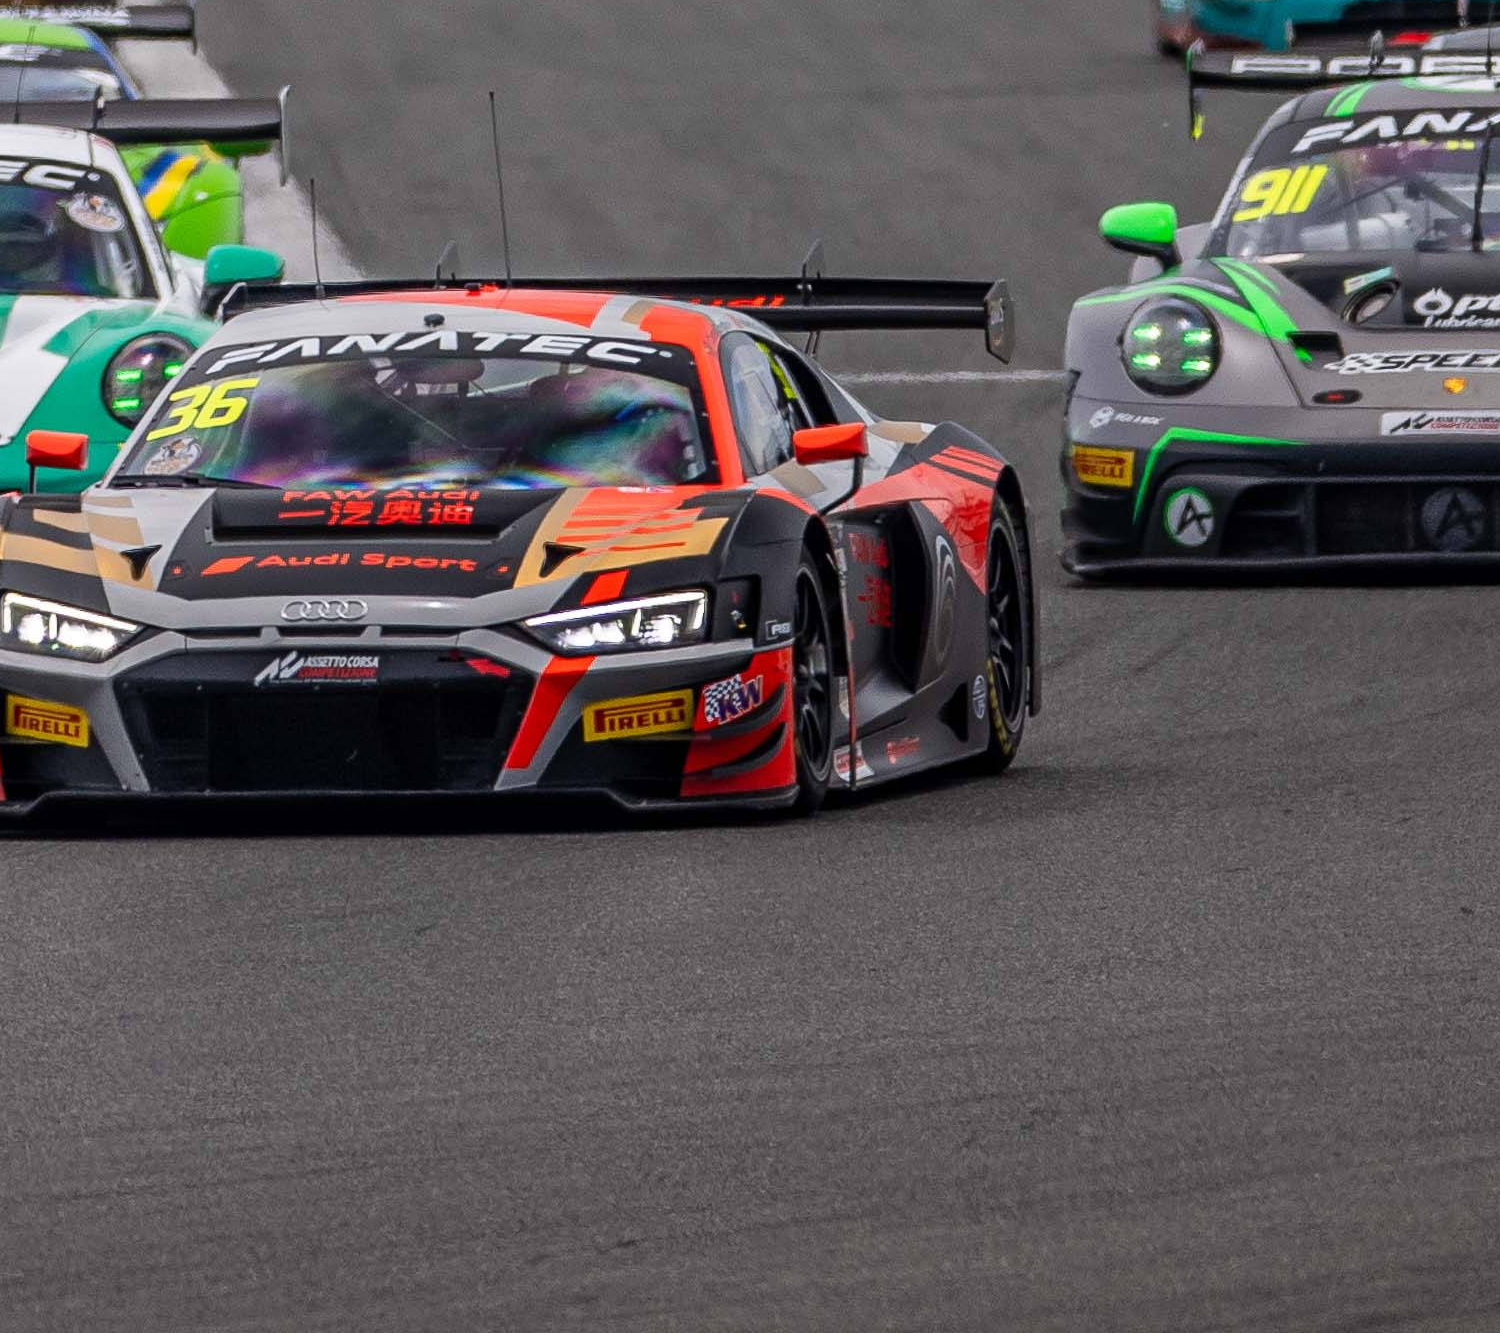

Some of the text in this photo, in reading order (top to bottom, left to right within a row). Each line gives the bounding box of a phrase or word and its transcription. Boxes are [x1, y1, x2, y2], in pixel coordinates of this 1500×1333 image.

[1231, 163, 1331, 222] 911
[206, 330, 660, 376] FANATEC
[146, 377, 260, 442] 36
[281, 488, 481, 503] FAW Audi
[278, 500, 474, 527] 一汽奥迪
[255, 552, 478, 572] Audi Sport
[302, 655, 379, 669] ASSETTO CORSA
[593, 697, 685, 733] PIRELLI
[717, 675, 764, 725] KW
[13, 704, 81, 739] PIRELLI
